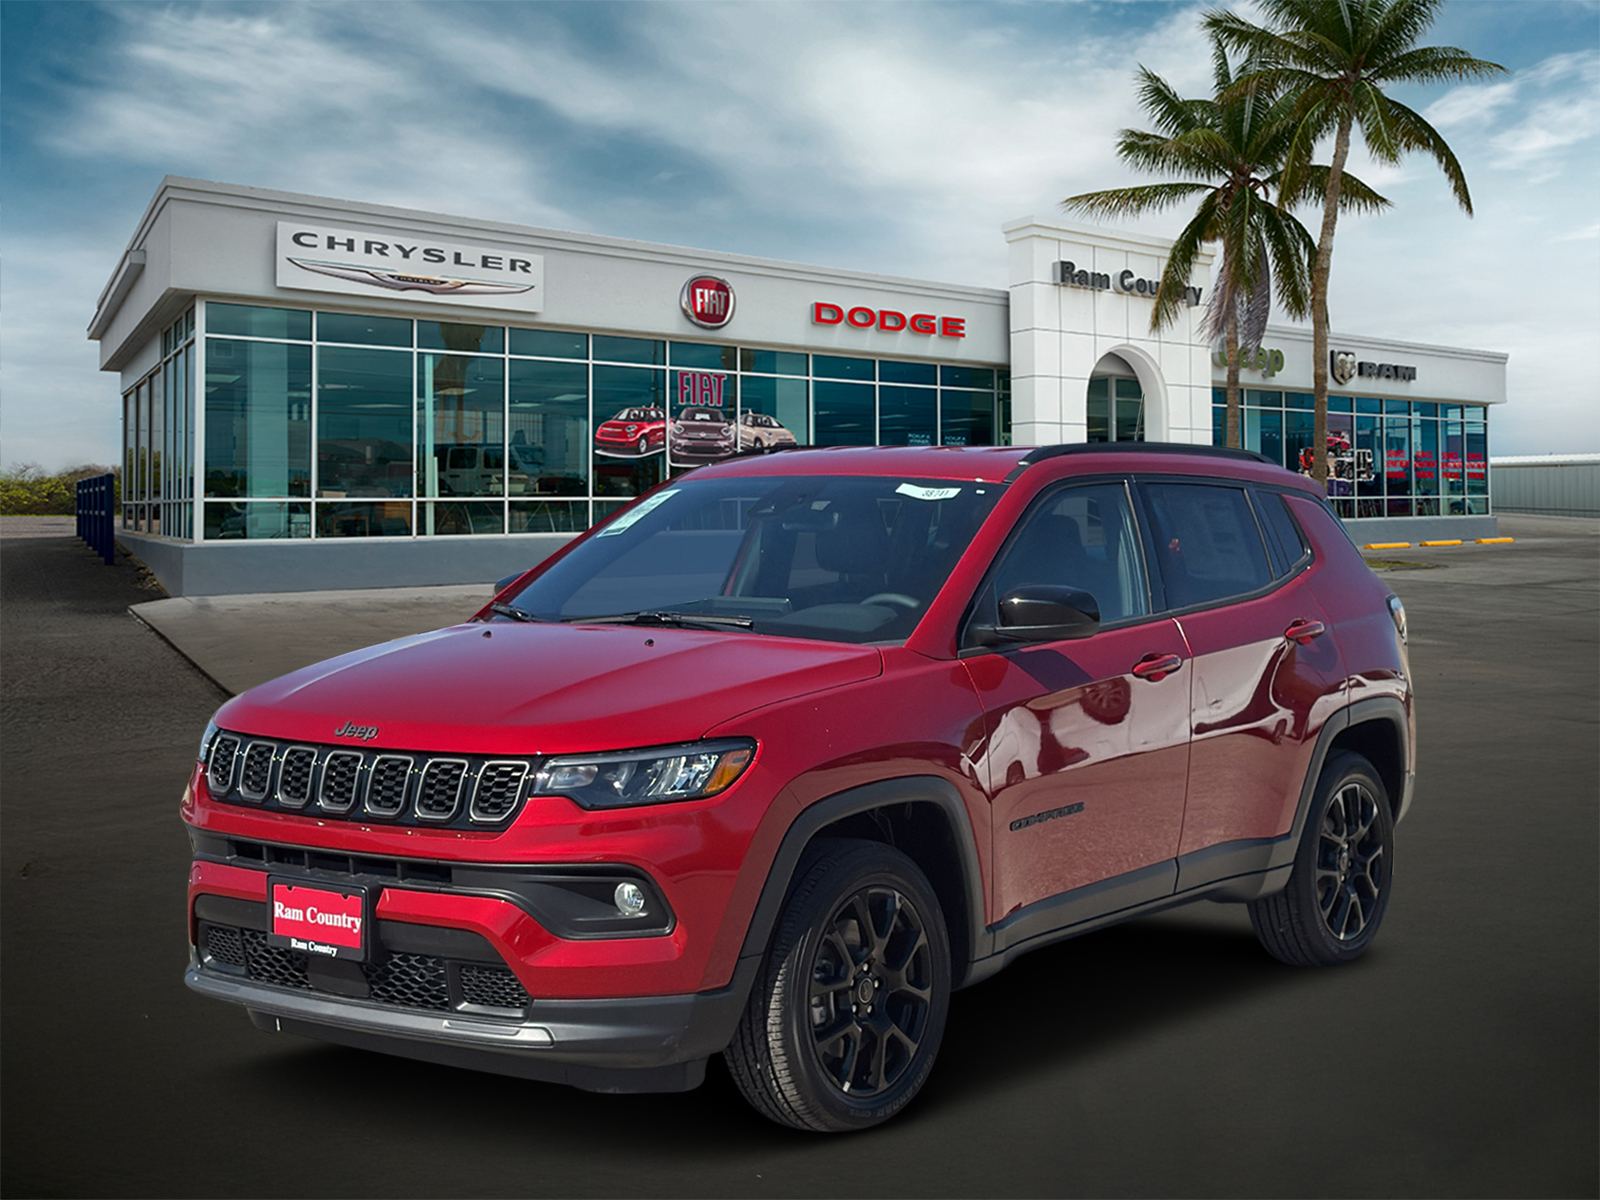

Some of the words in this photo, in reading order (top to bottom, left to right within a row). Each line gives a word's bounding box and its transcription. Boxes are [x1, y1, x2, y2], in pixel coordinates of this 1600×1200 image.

[291, 231, 532, 274] CHRYSLER
[1057, 260, 1110, 290] Ram
[1116, 268, 1203, 307] Coury
[695, 287, 728, 316] FIAT
[811, 301, 966, 339] DODGE
[1358, 361, 1417, 381] RAM
[678, 371, 728, 406] FIAT
[334, 720, 379, 742] Jeep
[273, 900, 304, 922] Ram
[306, 906, 362, 933] Country
[291, 937, 308, 950] Ram
[308, 941, 338, 957] Country
